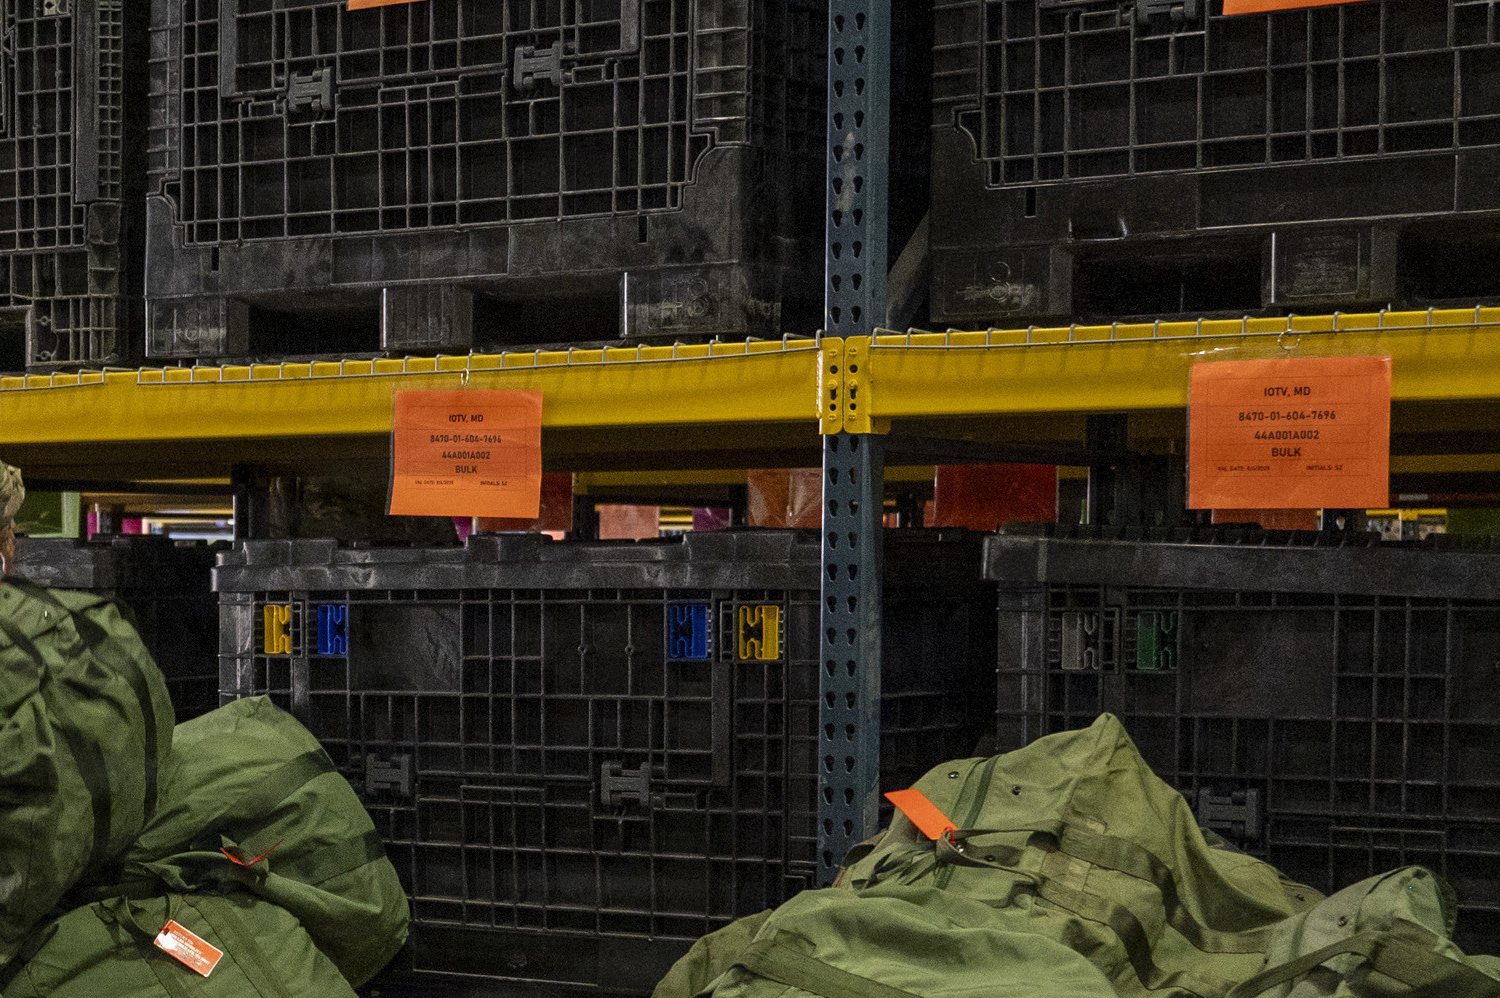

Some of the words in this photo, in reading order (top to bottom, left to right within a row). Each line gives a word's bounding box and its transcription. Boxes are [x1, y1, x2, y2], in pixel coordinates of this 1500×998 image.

[1263, 386, 1291, 398] IOTV,
[1294, 386, 1311, 396] MD
[448, 414, 469, 424] IOTV,
[470, 414, 484, 423] MD
[1238, 410, 1336, 422] 8470-01-604-7696
[1254, 430, 1320, 440] 44A001A002
[441, 451, 491, 460] 44A001A002
[1271, 447, 1302, 457] BULK
[455, 465, 478, 474] BULK
